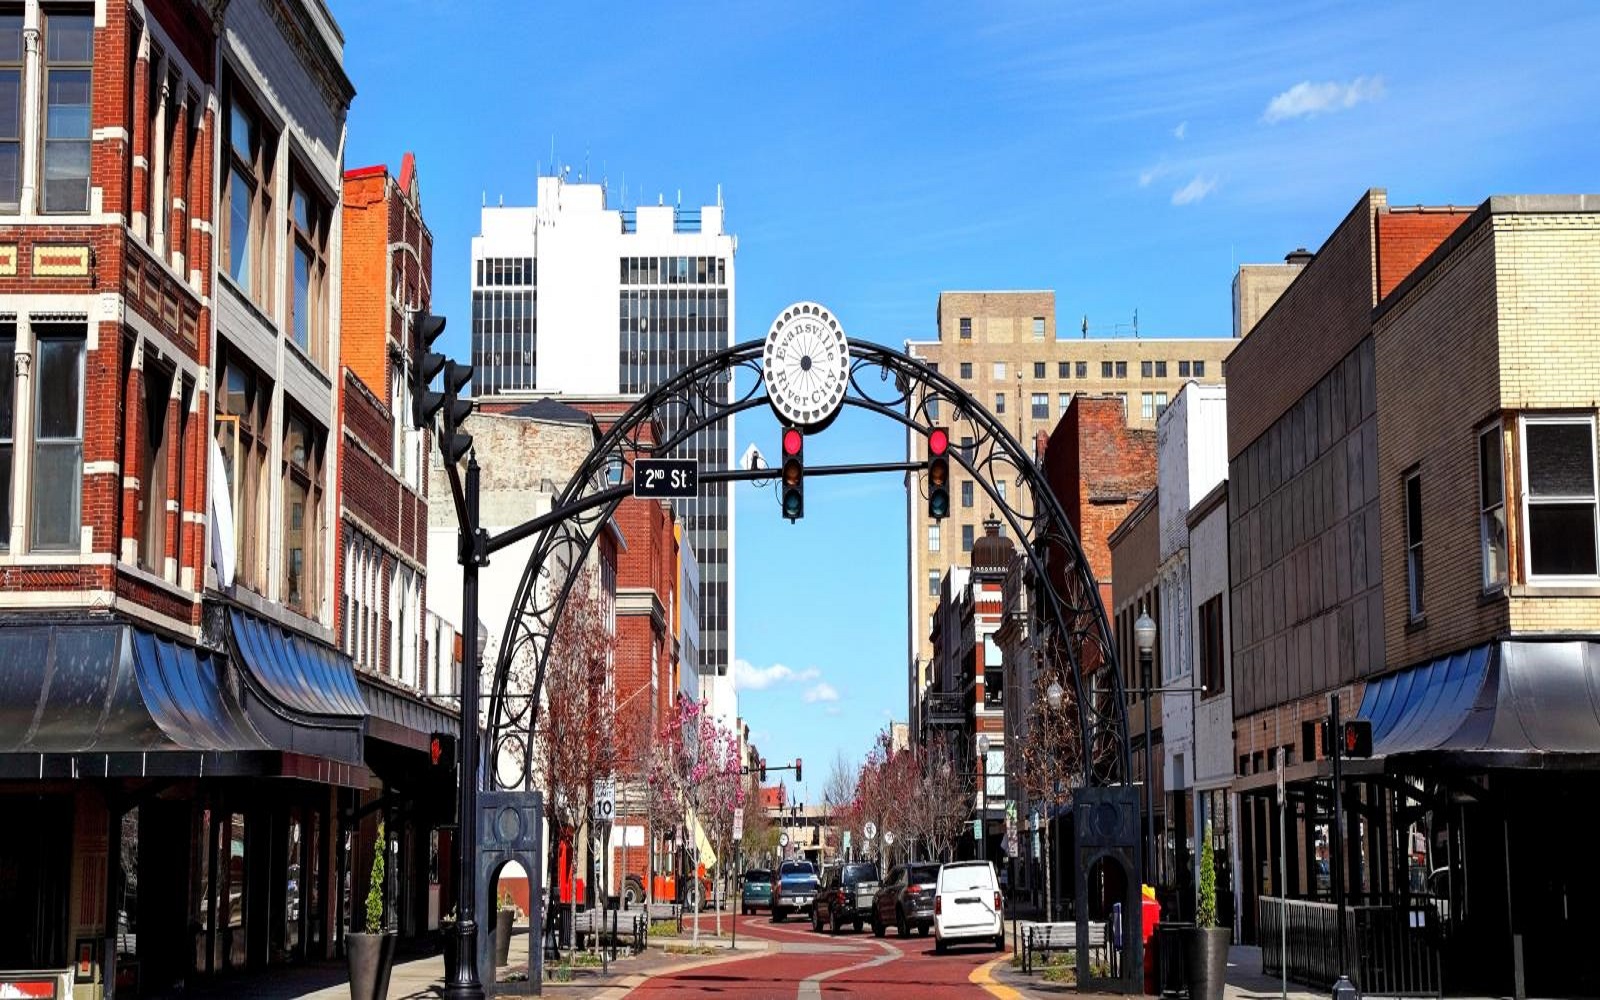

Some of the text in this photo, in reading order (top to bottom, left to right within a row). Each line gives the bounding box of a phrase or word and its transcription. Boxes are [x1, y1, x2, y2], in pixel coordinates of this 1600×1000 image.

[776, 323, 834, 361] Evansville
[776, 368, 837, 406] River City
[645, 468, 687, 488] 2ND St
[597, 800, 612, 815] 10
